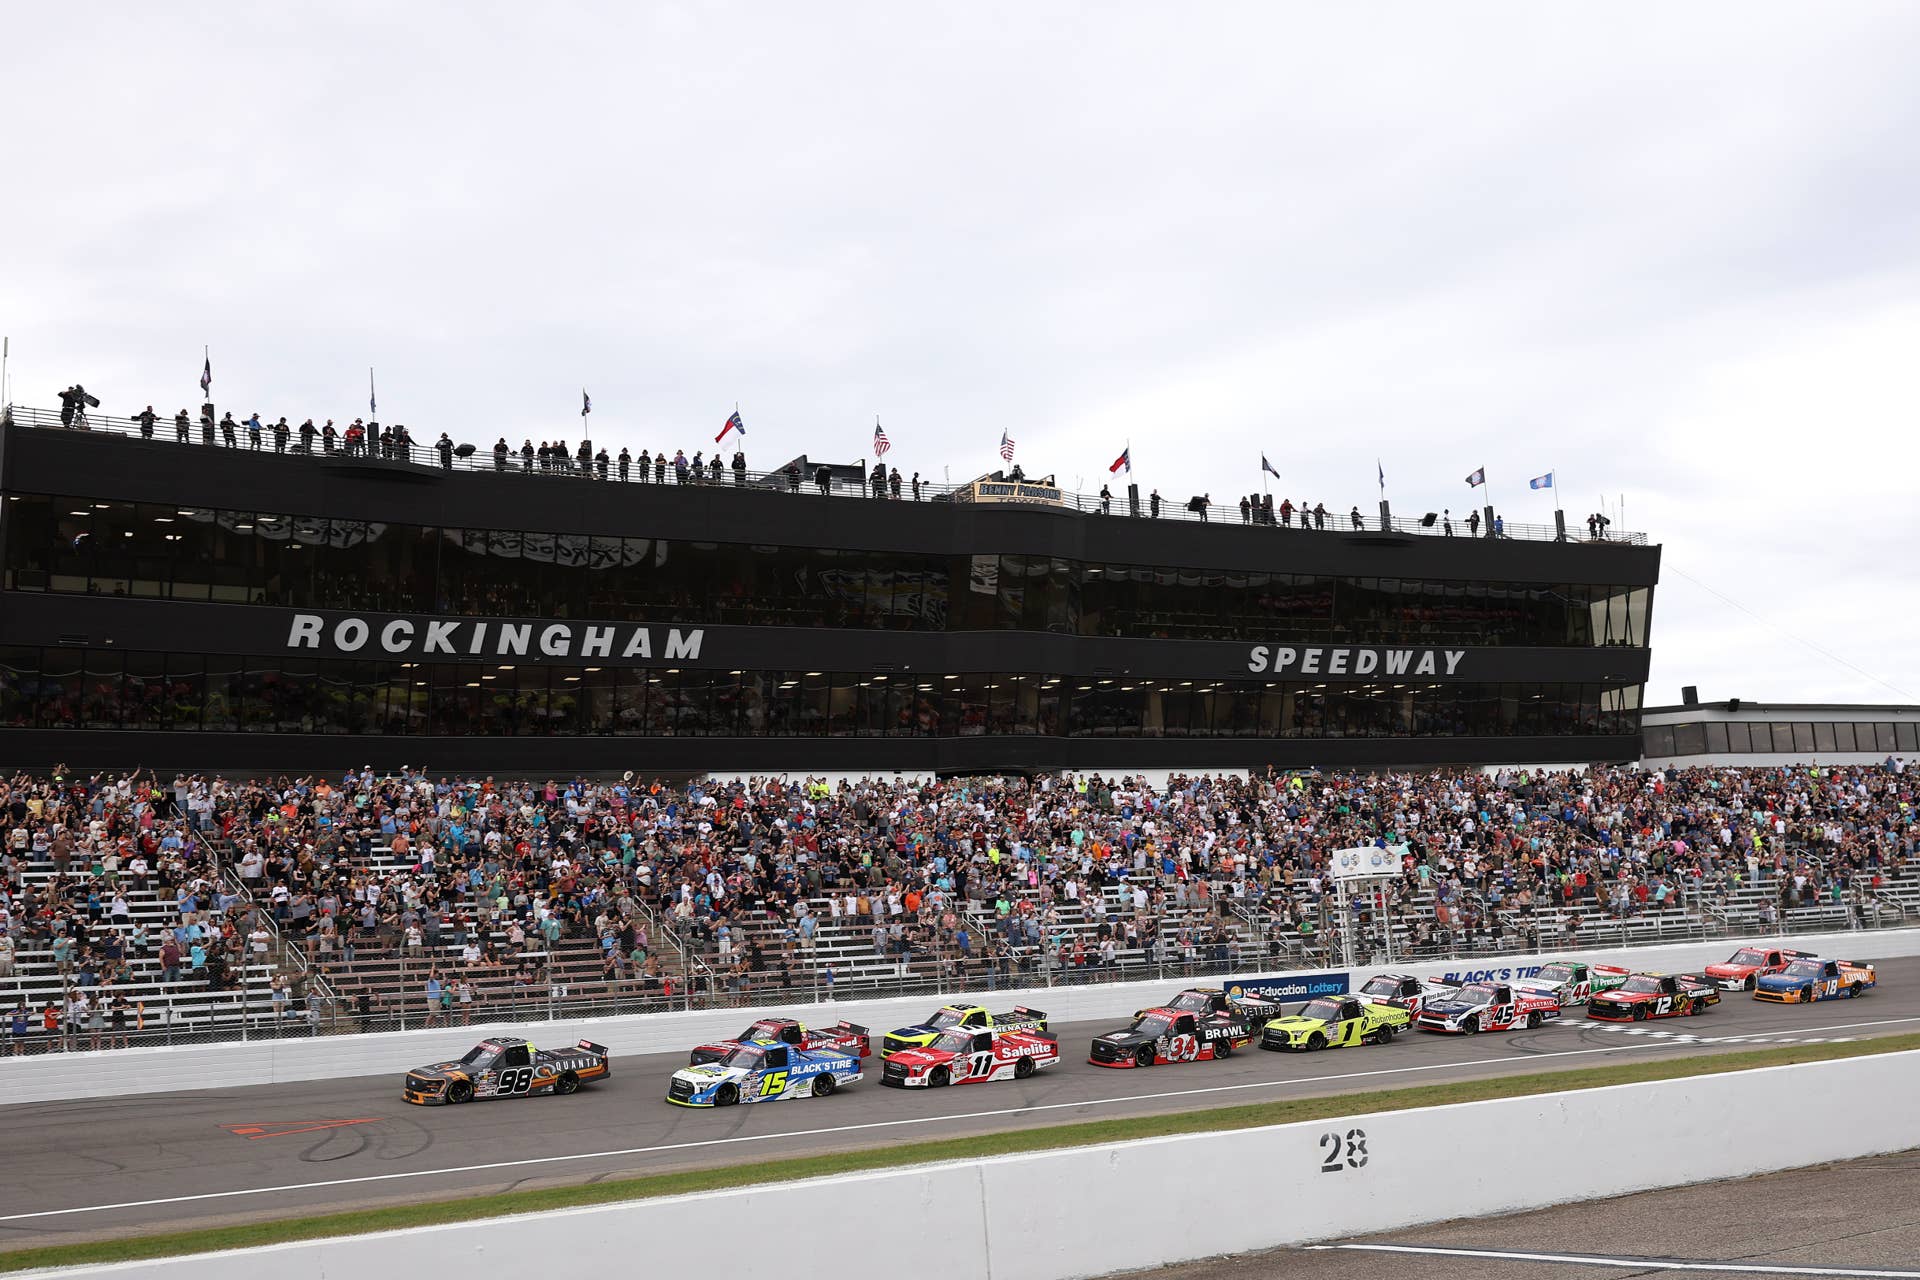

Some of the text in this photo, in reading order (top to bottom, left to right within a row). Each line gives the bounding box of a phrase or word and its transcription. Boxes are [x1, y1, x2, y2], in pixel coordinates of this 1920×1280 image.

[980, 484, 1060, 500] BENNY PARSONS
[287, 614, 704, 660] ROCKINGHAM
[1248, 646, 1465, 675] SPEEDWAY
[1444, 969, 1510, 983] BLACK'S
[1516, 966, 1541, 979] TIR
[1600, 976, 1627, 987] Precision
[1259, 984, 1307, 997] Education
[1308, 982, 1343, 994] Lottery
[1573, 983, 1590, 1000] 44
[1687, 988, 1715, 997] Cummins
[1825, 979, 1838, 996] 18
[1242, 1005, 1275, 1017] VETTED
[1655, 996, 1672, 1015] 12
[1371, 1011, 1405, 1024] Robinhood
[1493, 1005, 1514, 1024] 45
[993, 1022, 1040, 1034] MENARDS
[1343, 1022, 1354, 1042] 1
[807, 1038, 835, 1050] Atlan
[1002, 1043, 1051, 1059] Safelite
[1170, 1034, 1196, 1057] 34
[556, 1058, 598, 1072] QUANTA
[791, 1062, 830, 1075] BLACK'S
[832, 1059, 852, 1070] TIRE
[970, 1054, 994, 1077] 11
[495, 1067, 534, 1096] 98
[759, 1071, 789, 1097] 15
[1320, 1128, 1368, 1173] 28
